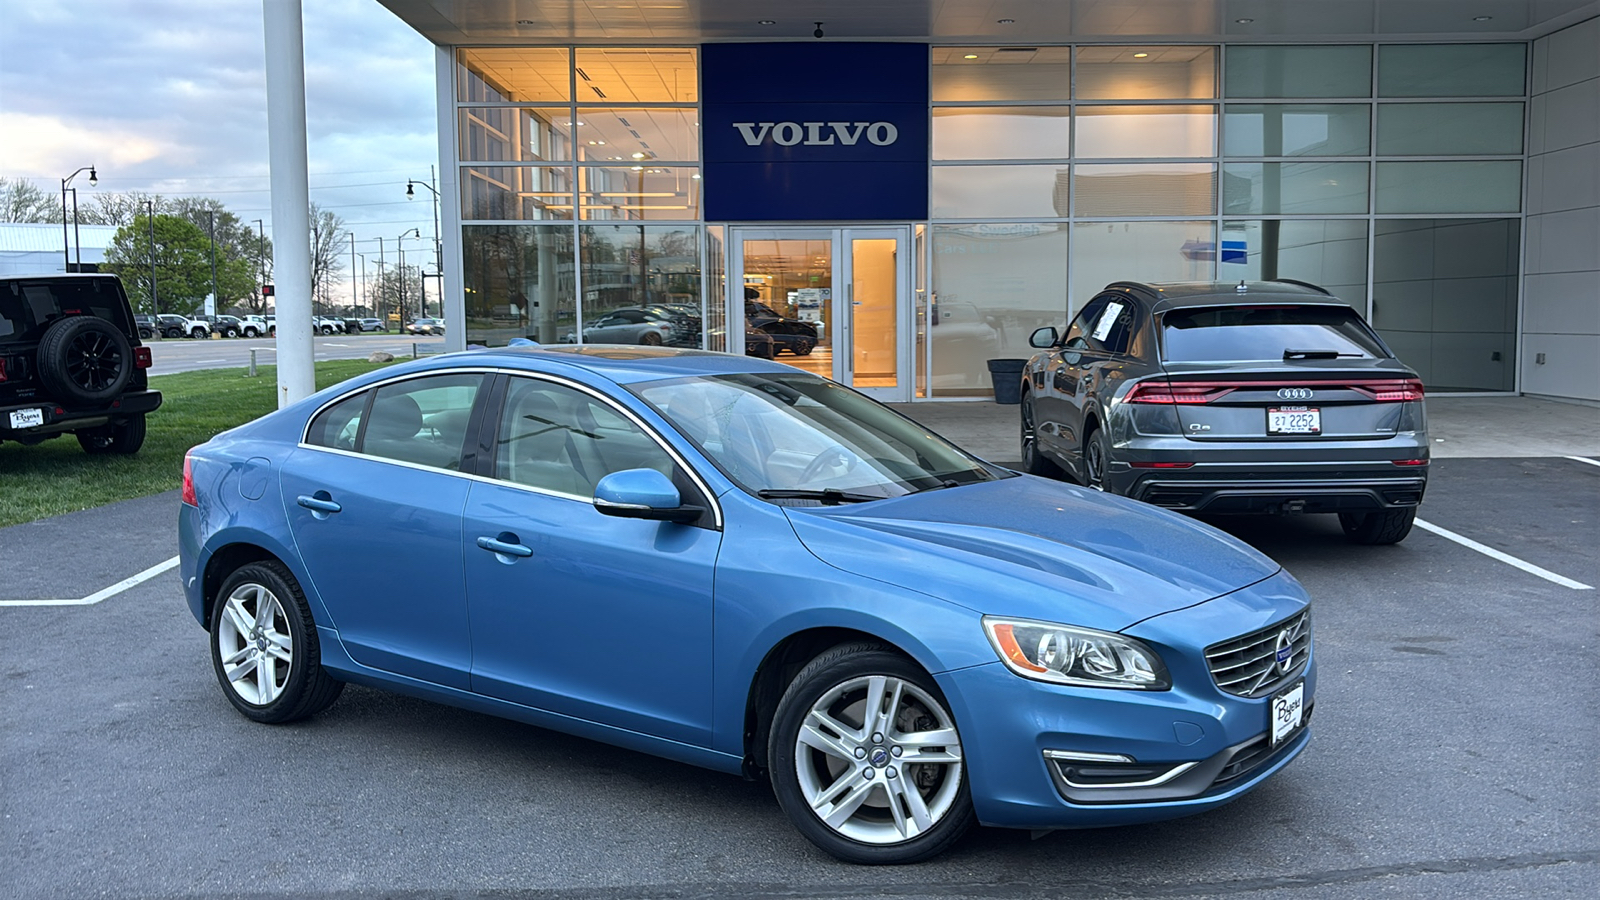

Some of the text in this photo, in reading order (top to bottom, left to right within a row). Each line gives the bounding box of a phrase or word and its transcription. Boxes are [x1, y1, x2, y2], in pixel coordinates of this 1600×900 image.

[732, 121, 898, 146] VOLVO
[979, 224, 1040, 236] Swedish
[934, 242, 966, 253] Cars
[1275, 414, 1315, 428] 27 2252
